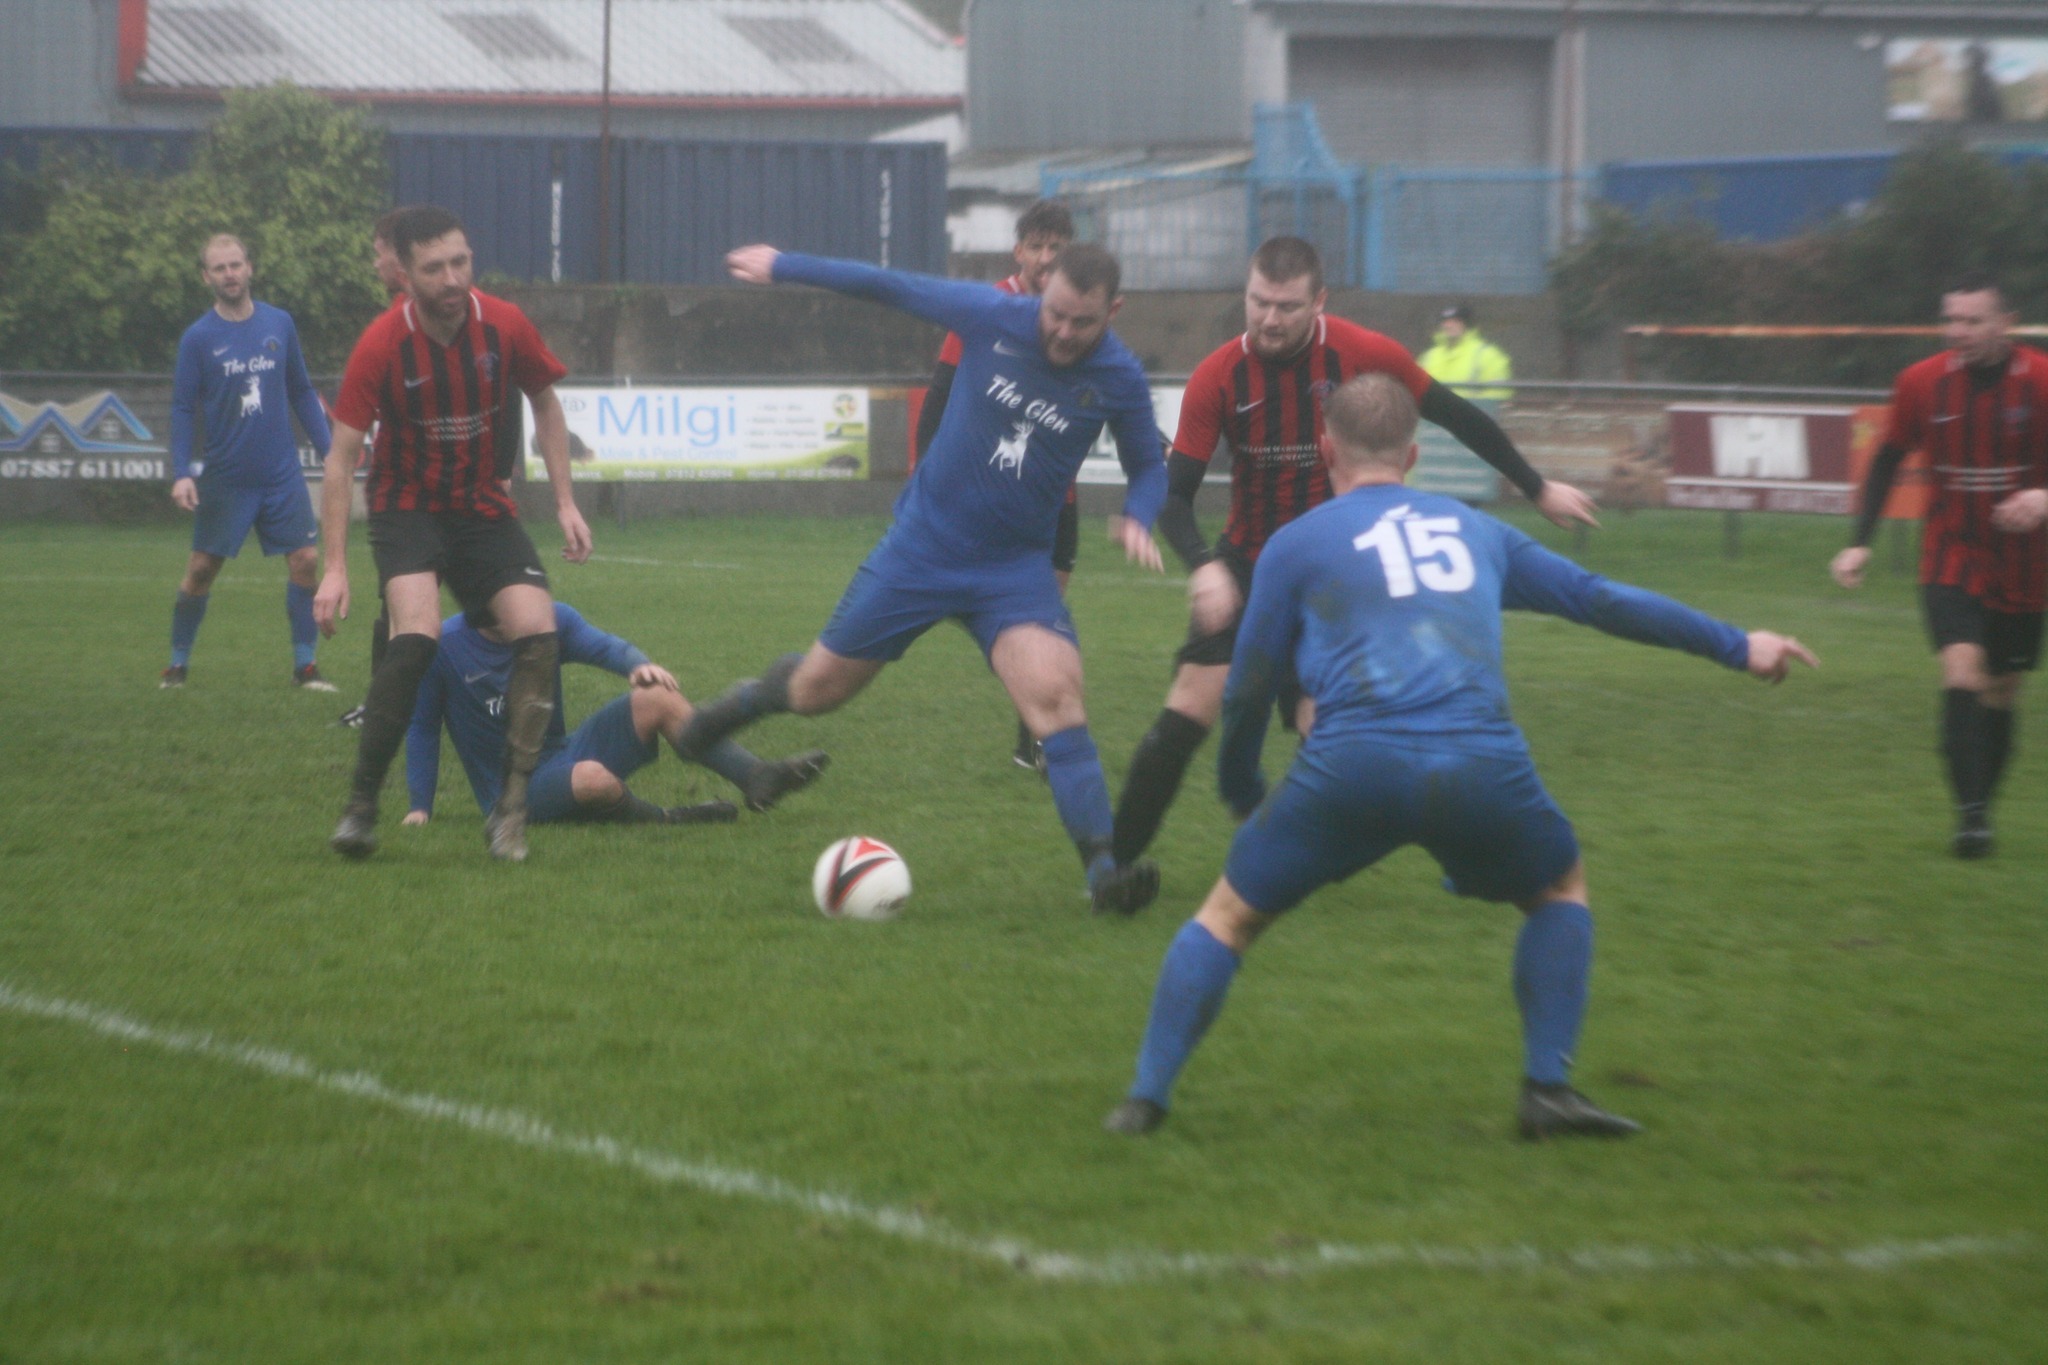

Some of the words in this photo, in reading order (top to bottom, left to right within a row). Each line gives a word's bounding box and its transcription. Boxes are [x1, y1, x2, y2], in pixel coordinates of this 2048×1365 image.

[223, 359, 246, 377] The
[248, 354, 276, 373] Glen
[597, 394, 737, 447] Milgi
[986, 374, 1023, 409] The
[1025, 398, 1070, 435] Glen
[79, 459, 165, 479] 611001
[1352, 514, 1476, 598] 15
